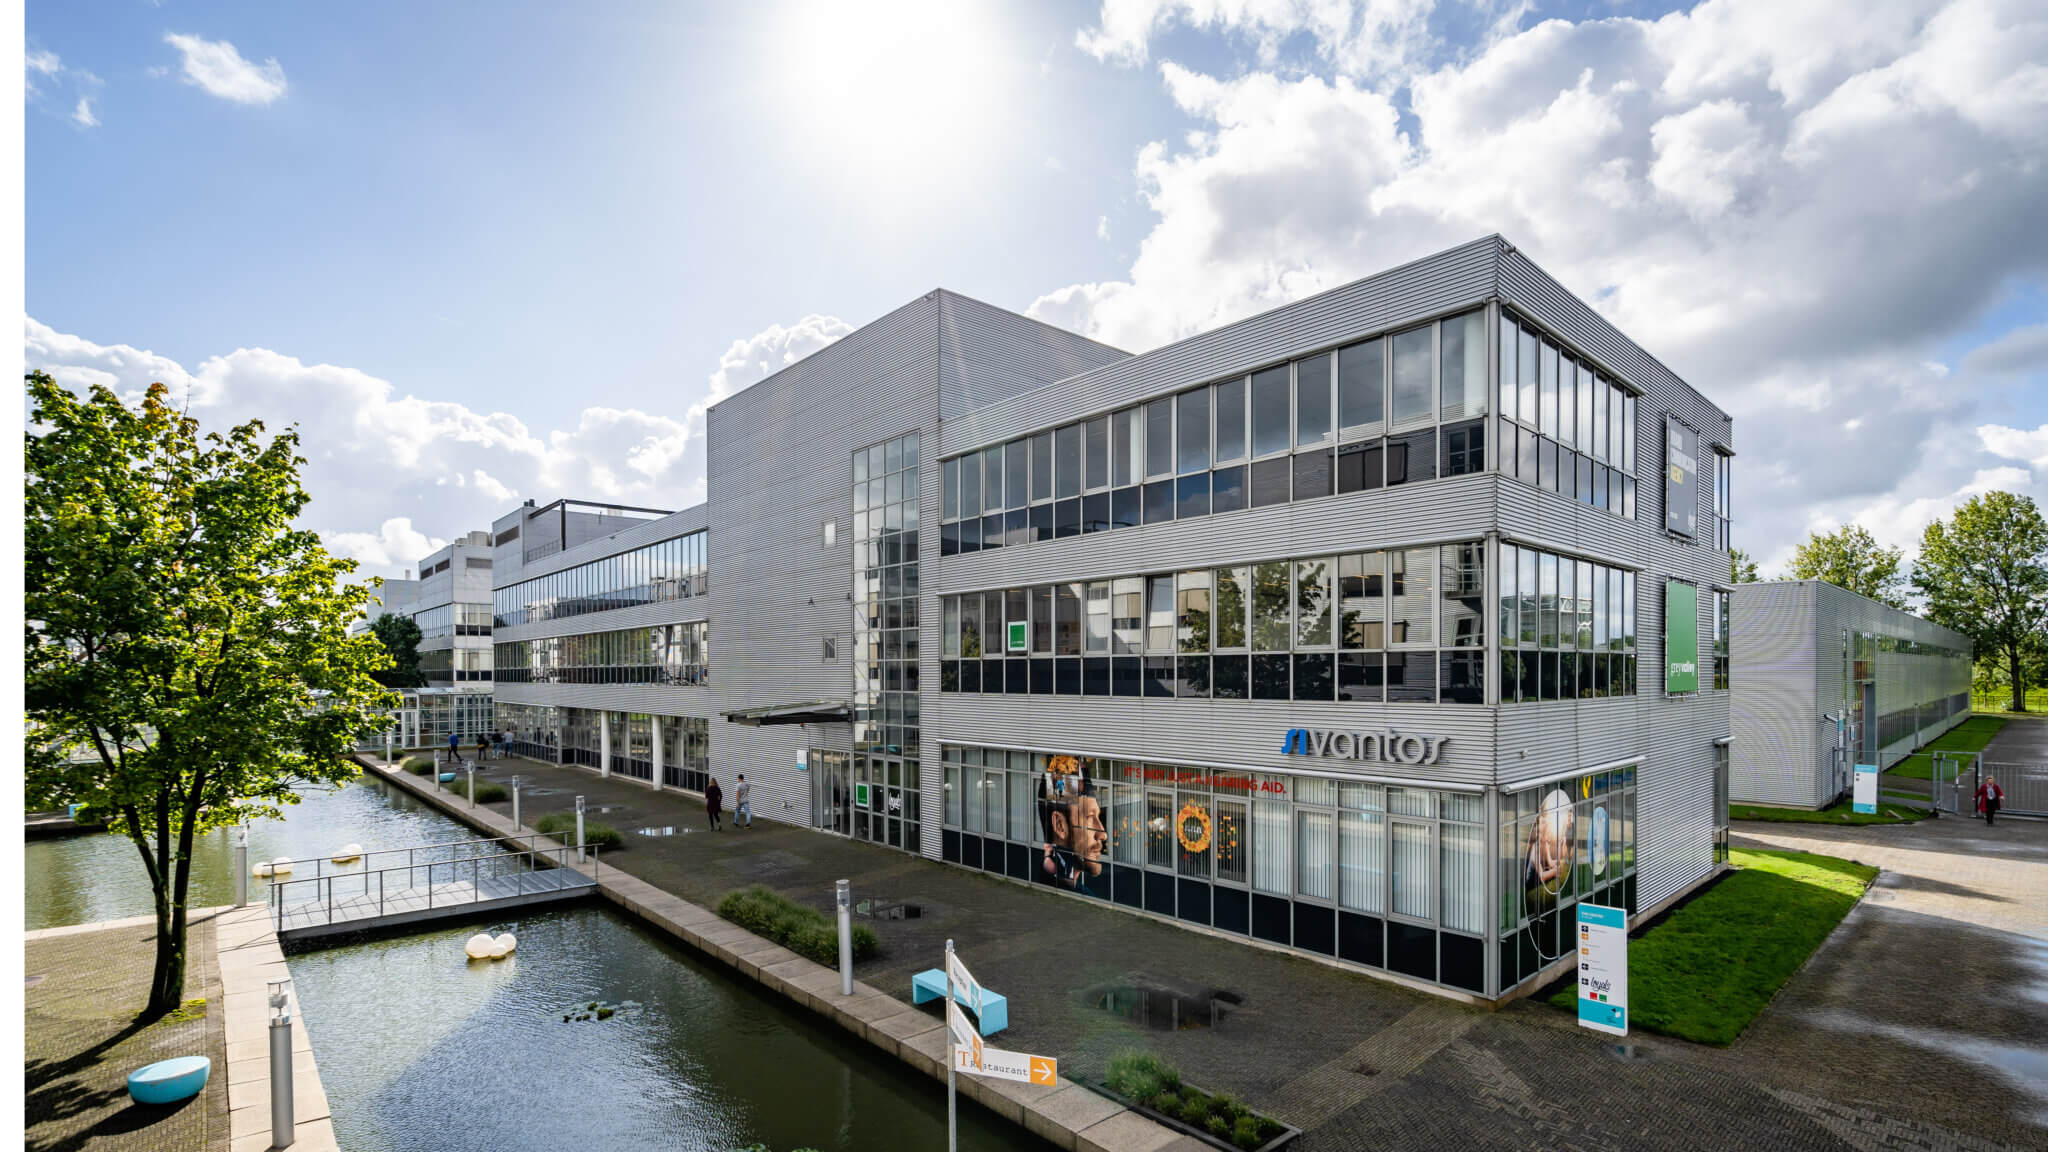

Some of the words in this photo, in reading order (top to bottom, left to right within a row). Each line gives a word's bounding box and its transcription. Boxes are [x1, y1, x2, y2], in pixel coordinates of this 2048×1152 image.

[1124, 766, 1142, 779] IT'S
[1144, 768, 1165, 781] NOT
[1167, 770, 1192, 784] JUST
[1195, 773, 1203, 785] A
[1204, 775, 1258, 792] HEARING
[1261, 780, 1288, 794] AID.
[970, 1059, 1028, 1077] Rstaurant
